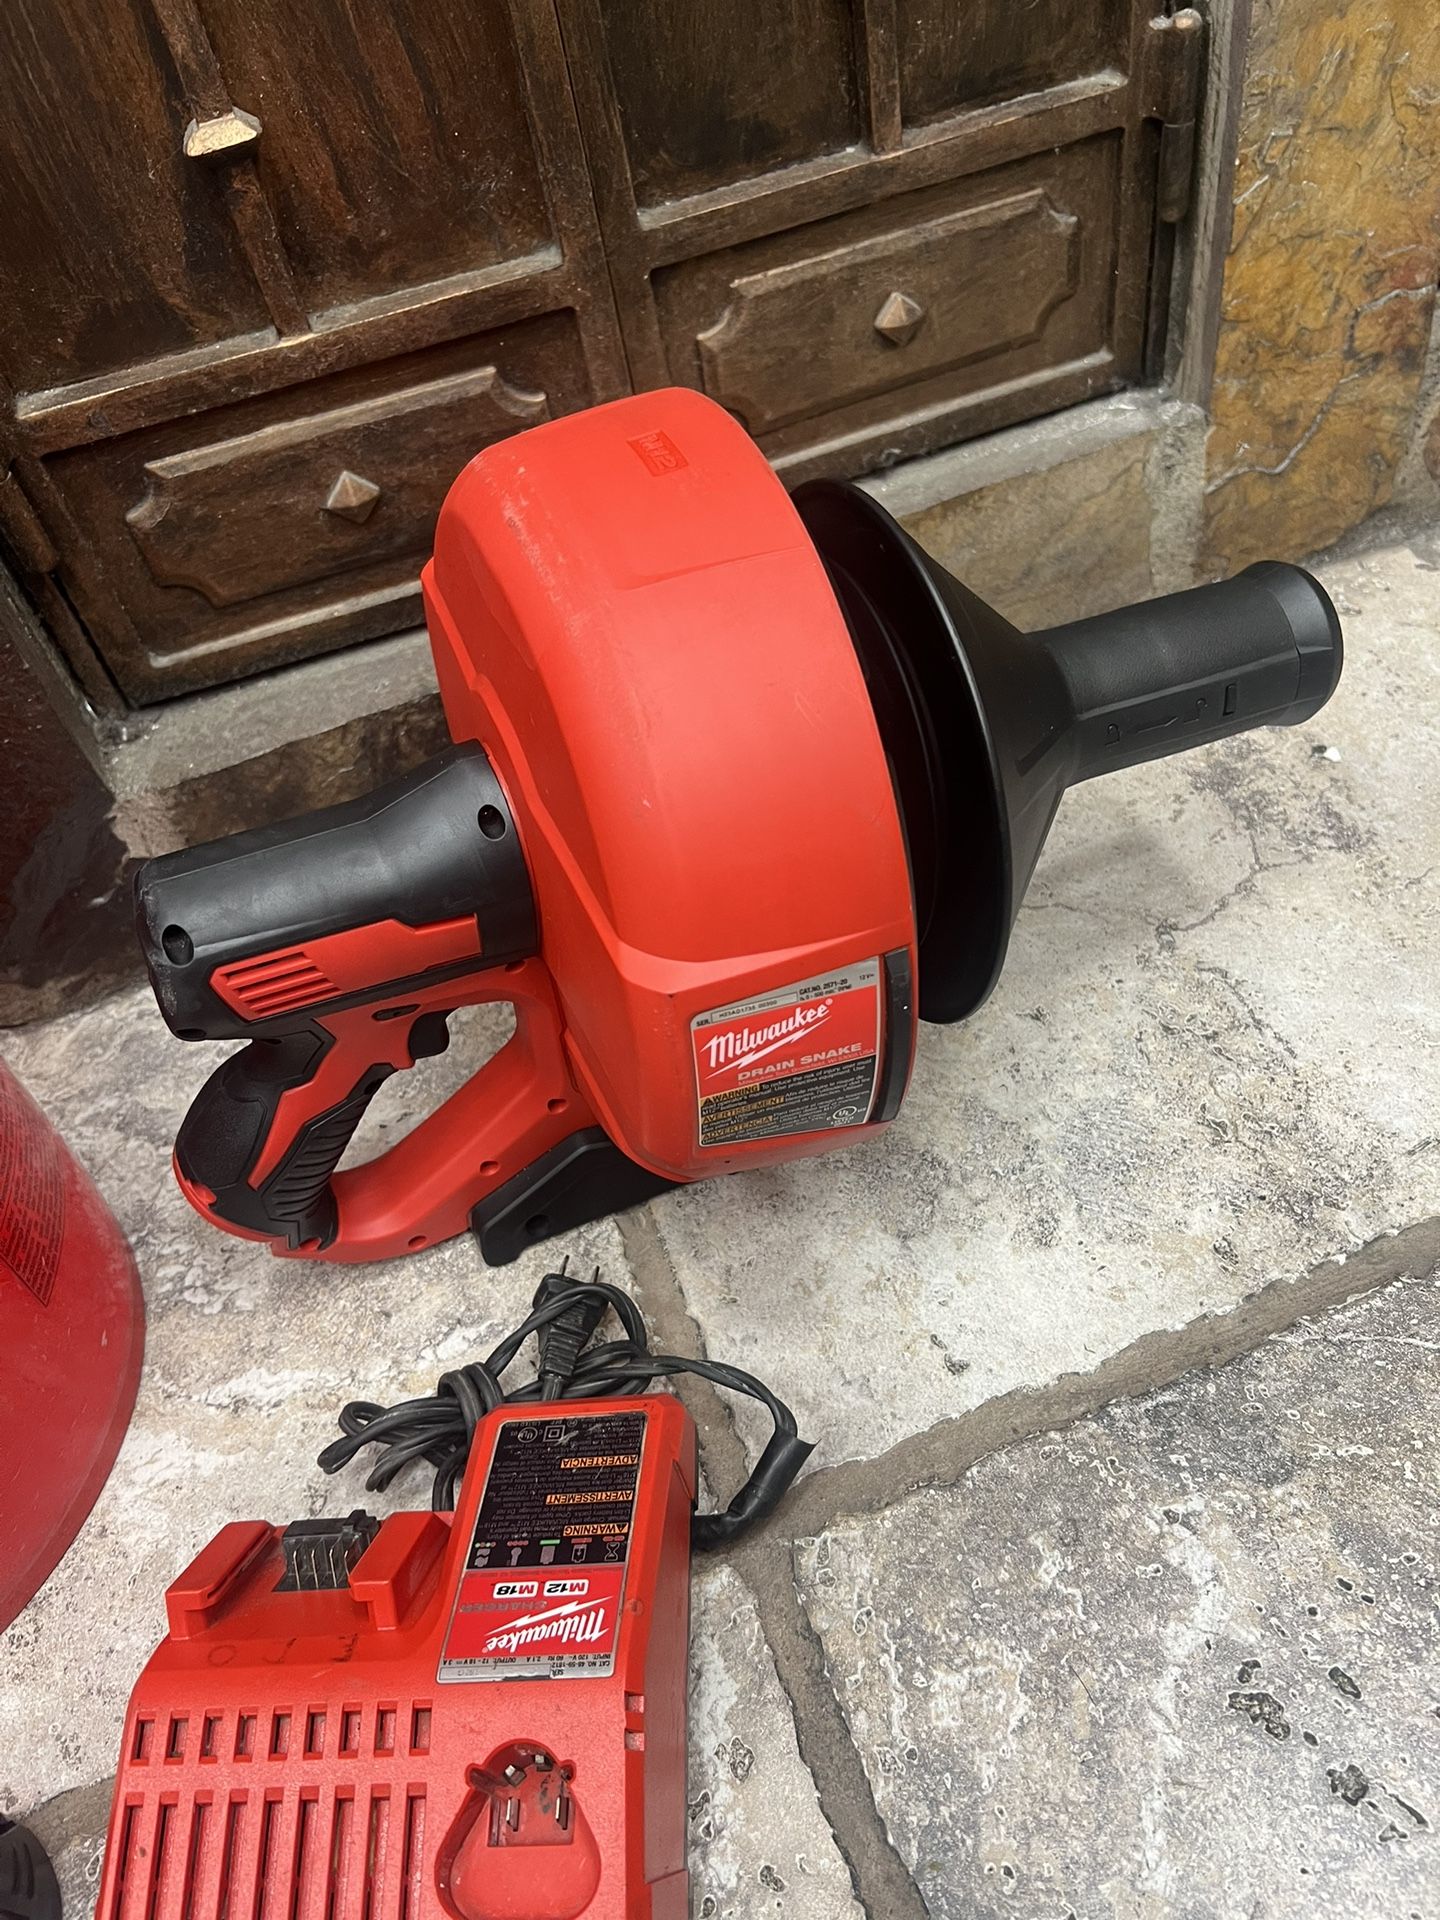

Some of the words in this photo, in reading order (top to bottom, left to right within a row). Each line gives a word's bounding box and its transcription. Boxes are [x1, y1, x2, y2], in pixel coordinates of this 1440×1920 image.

[737, 1057, 795, 1081] DRAIN
[800, 1043, 862, 1065] SNAKE
[712, 1084, 759, 1103] WARNING
[562, 1455, 637, 1467] ADVERTENCIA
[547, 1491, 631, 1503] AVERTISSEMENT
[564, 1524, 615, 1535] WARNING
[496, 1584, 535, 1595] M18
[547, 1582, 585, 1593] M12
